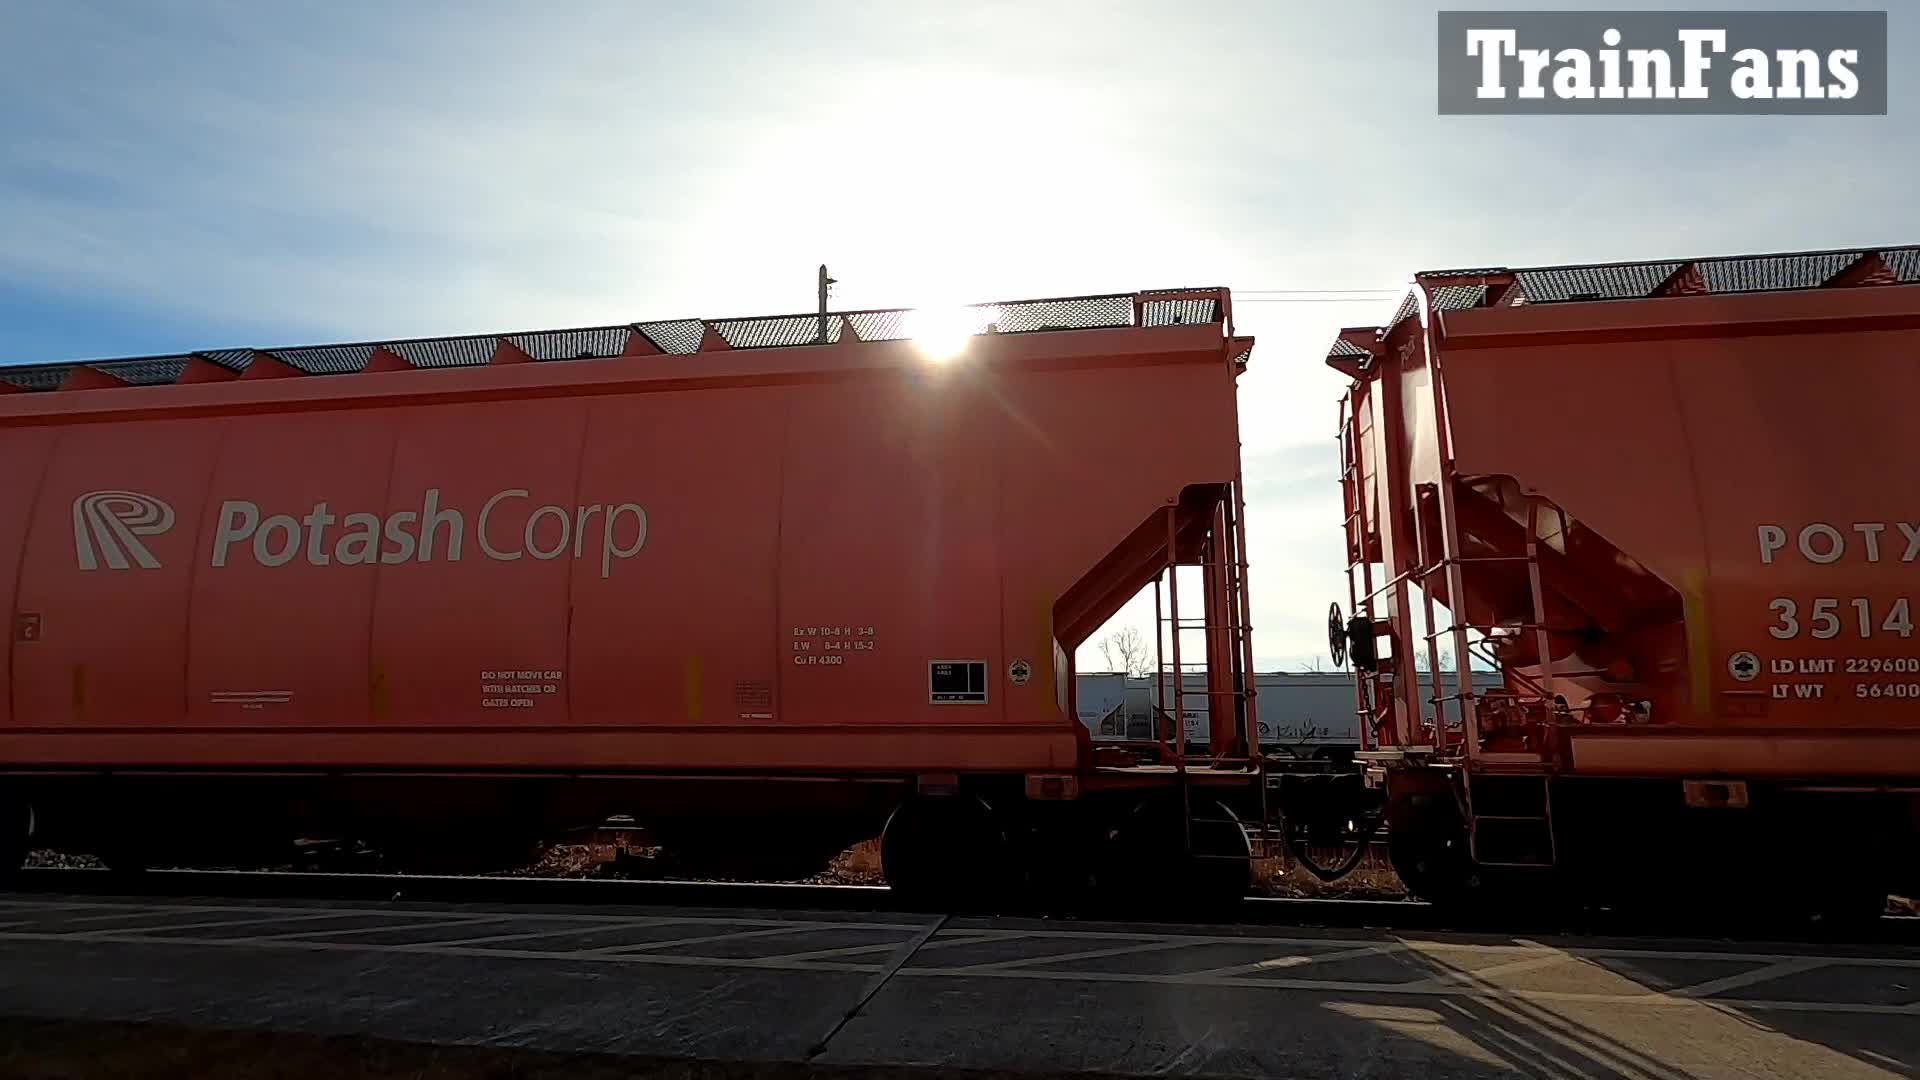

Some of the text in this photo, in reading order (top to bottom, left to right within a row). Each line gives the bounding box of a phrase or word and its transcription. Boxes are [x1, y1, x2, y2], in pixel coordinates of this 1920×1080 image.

[1772, 659, 1794, 673] LD
[1800, 659, 1835, 673] LMT
[1773, 685, 1789, 698] LT
[1795, 685, 1824, 698] WT
